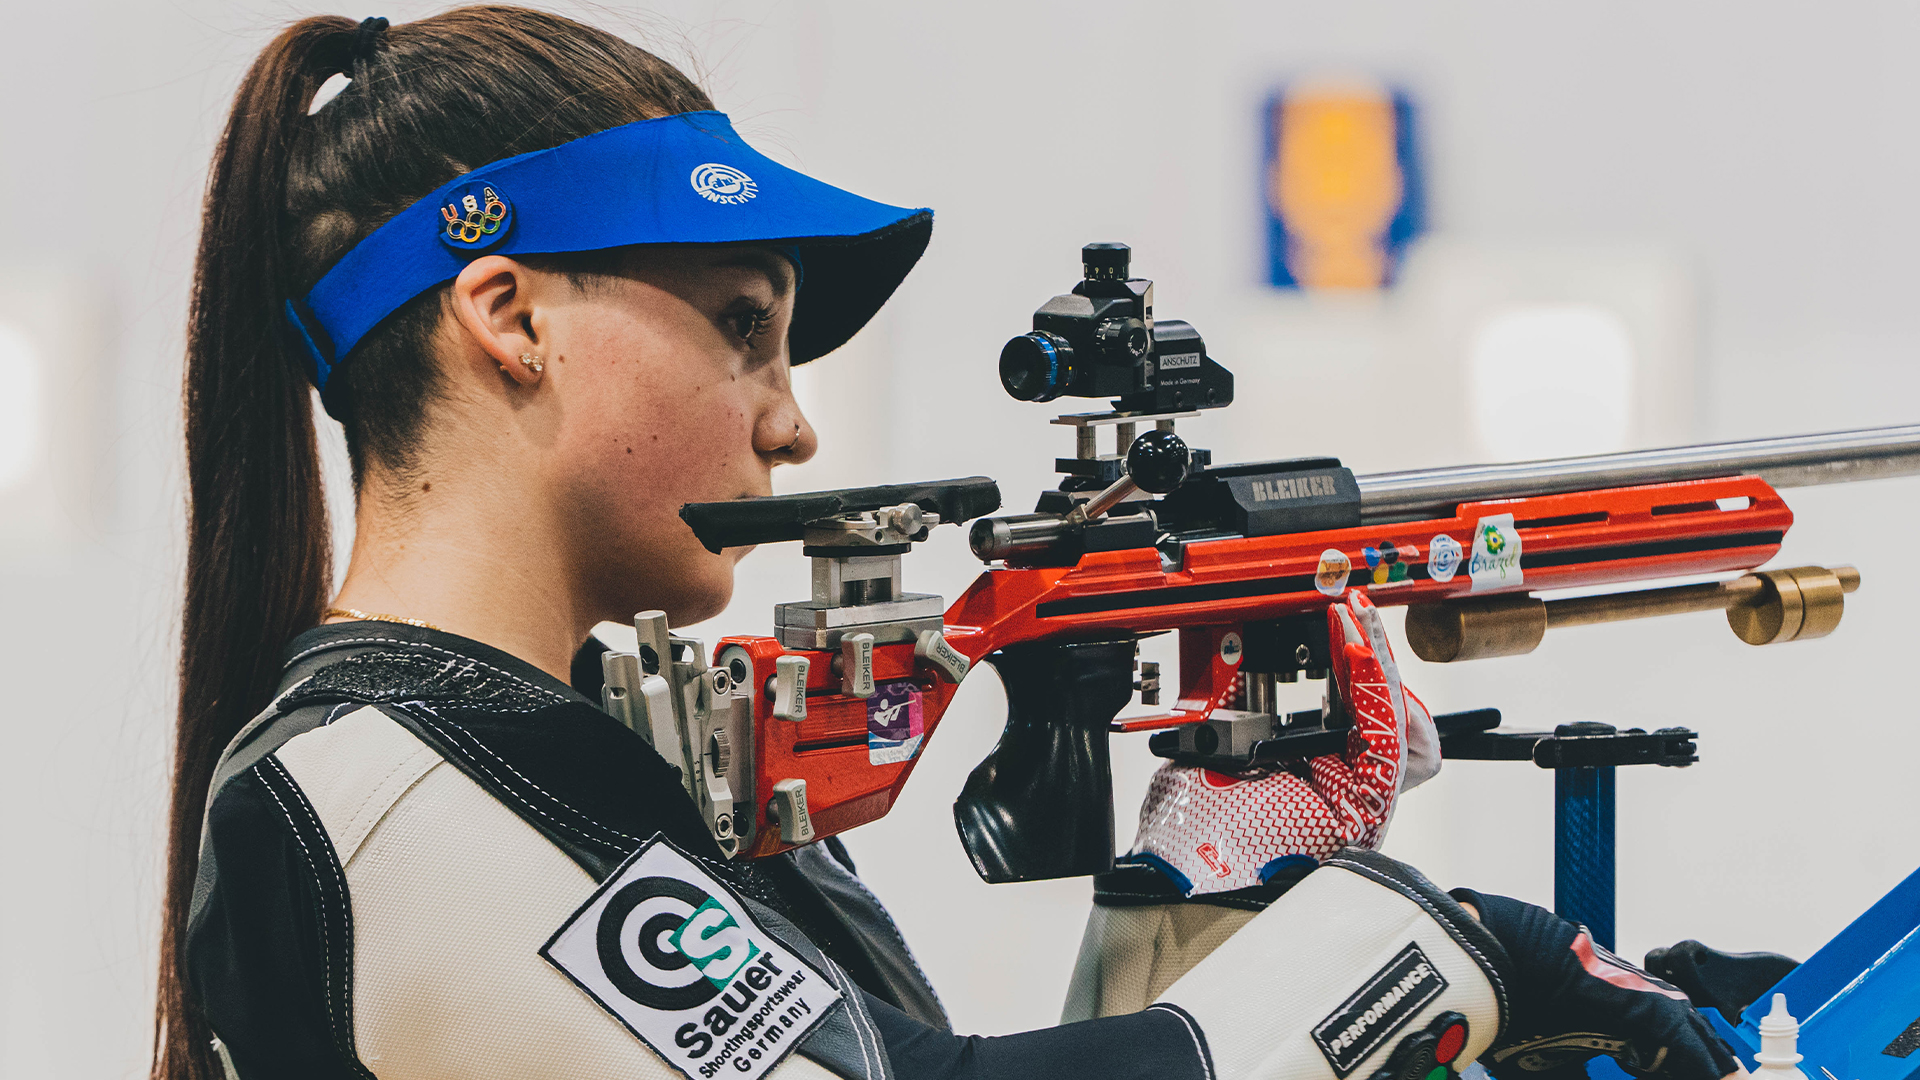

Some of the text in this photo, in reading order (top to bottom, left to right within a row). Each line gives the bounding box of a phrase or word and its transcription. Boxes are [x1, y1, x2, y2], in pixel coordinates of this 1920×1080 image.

[441, 186, 500, 222] USA
[1179, 377, 1201, 386] Germany
[1251, 475, 1337, 502] BLEIKER
[862, 641, 871, 691] BLEIKER
[936, 641, 966, 674] BLEIKER
[794, 664, 806, 714] BLEIKER
[795, 788, 808, 836] BLEIKER
[674, 951, 783, 1060] Sauer
[698, 969, 806, 1079] Shootingsportswear
[1329, 962, 1431, 1056] PERFORMANCE
[732, 996, 812, 1074] Germany
